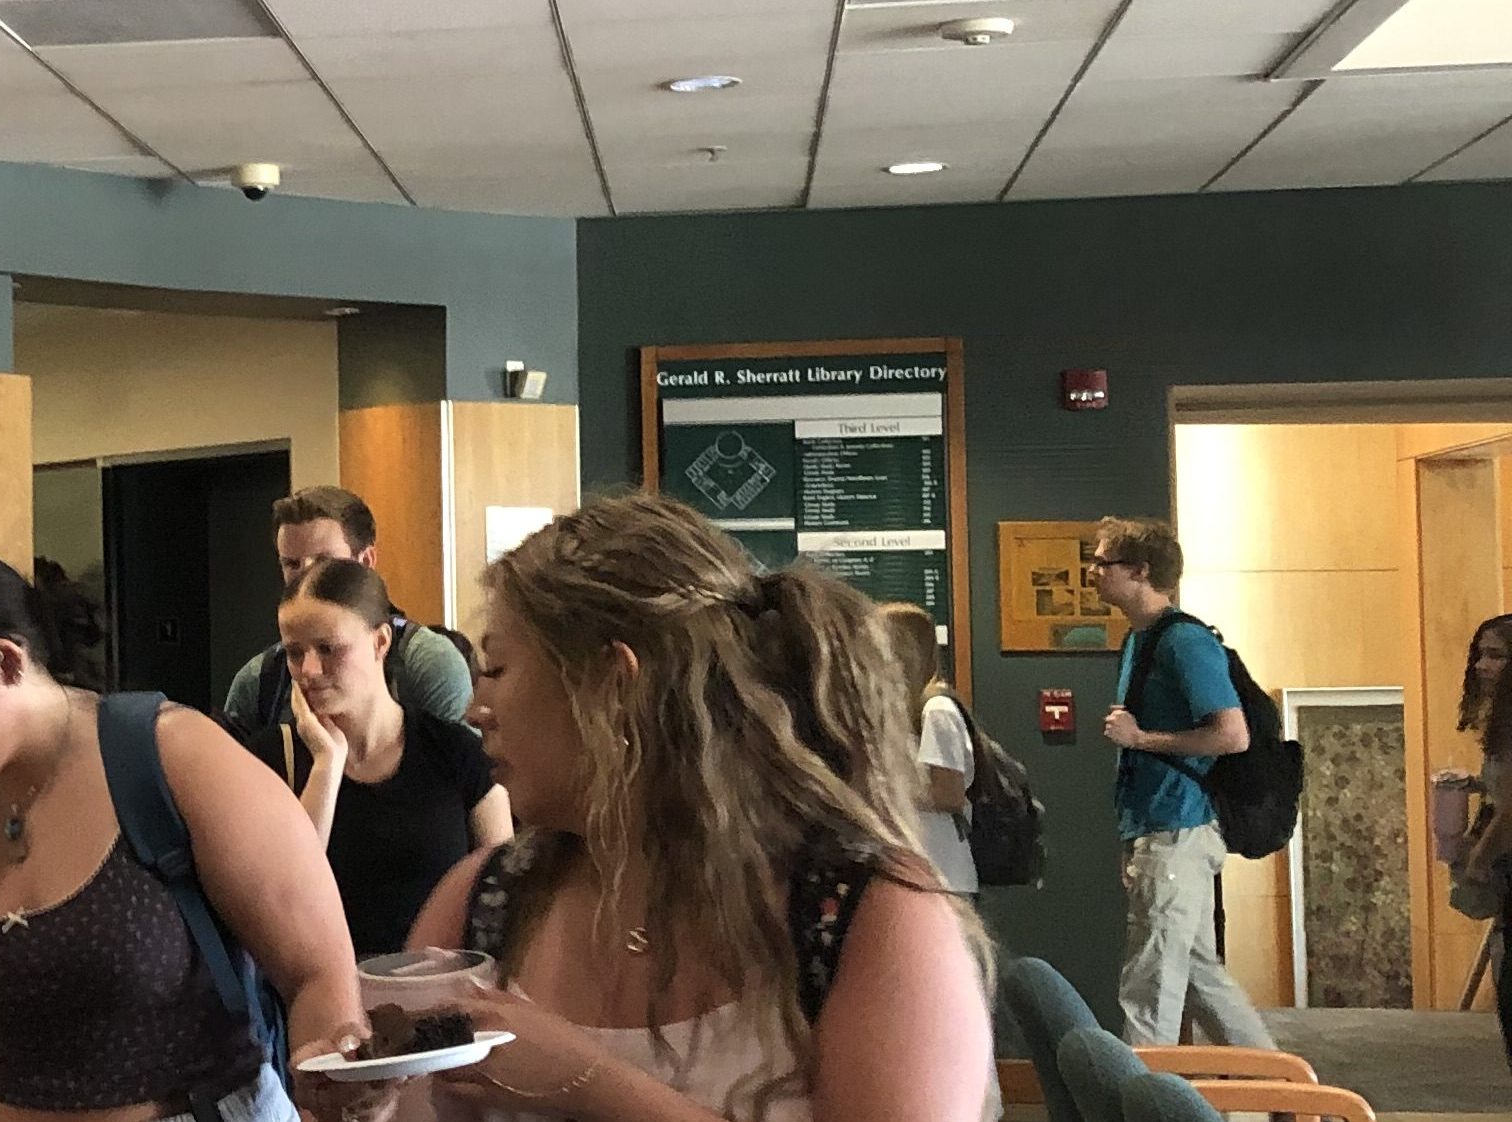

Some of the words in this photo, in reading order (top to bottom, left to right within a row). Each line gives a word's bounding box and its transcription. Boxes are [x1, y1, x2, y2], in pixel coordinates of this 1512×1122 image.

[656, 370, 708, 387] Gerald
[714, 370, 731, 385] R.
[737, 368, 801, 385] Sherratt
[807, 367, 863, 384] Library
[869, 365, 947, 382] Directory
[839, 422, 866, 434] Third
[870, 421, 900, 433] Level
[881, 535, 911, 547] Level
